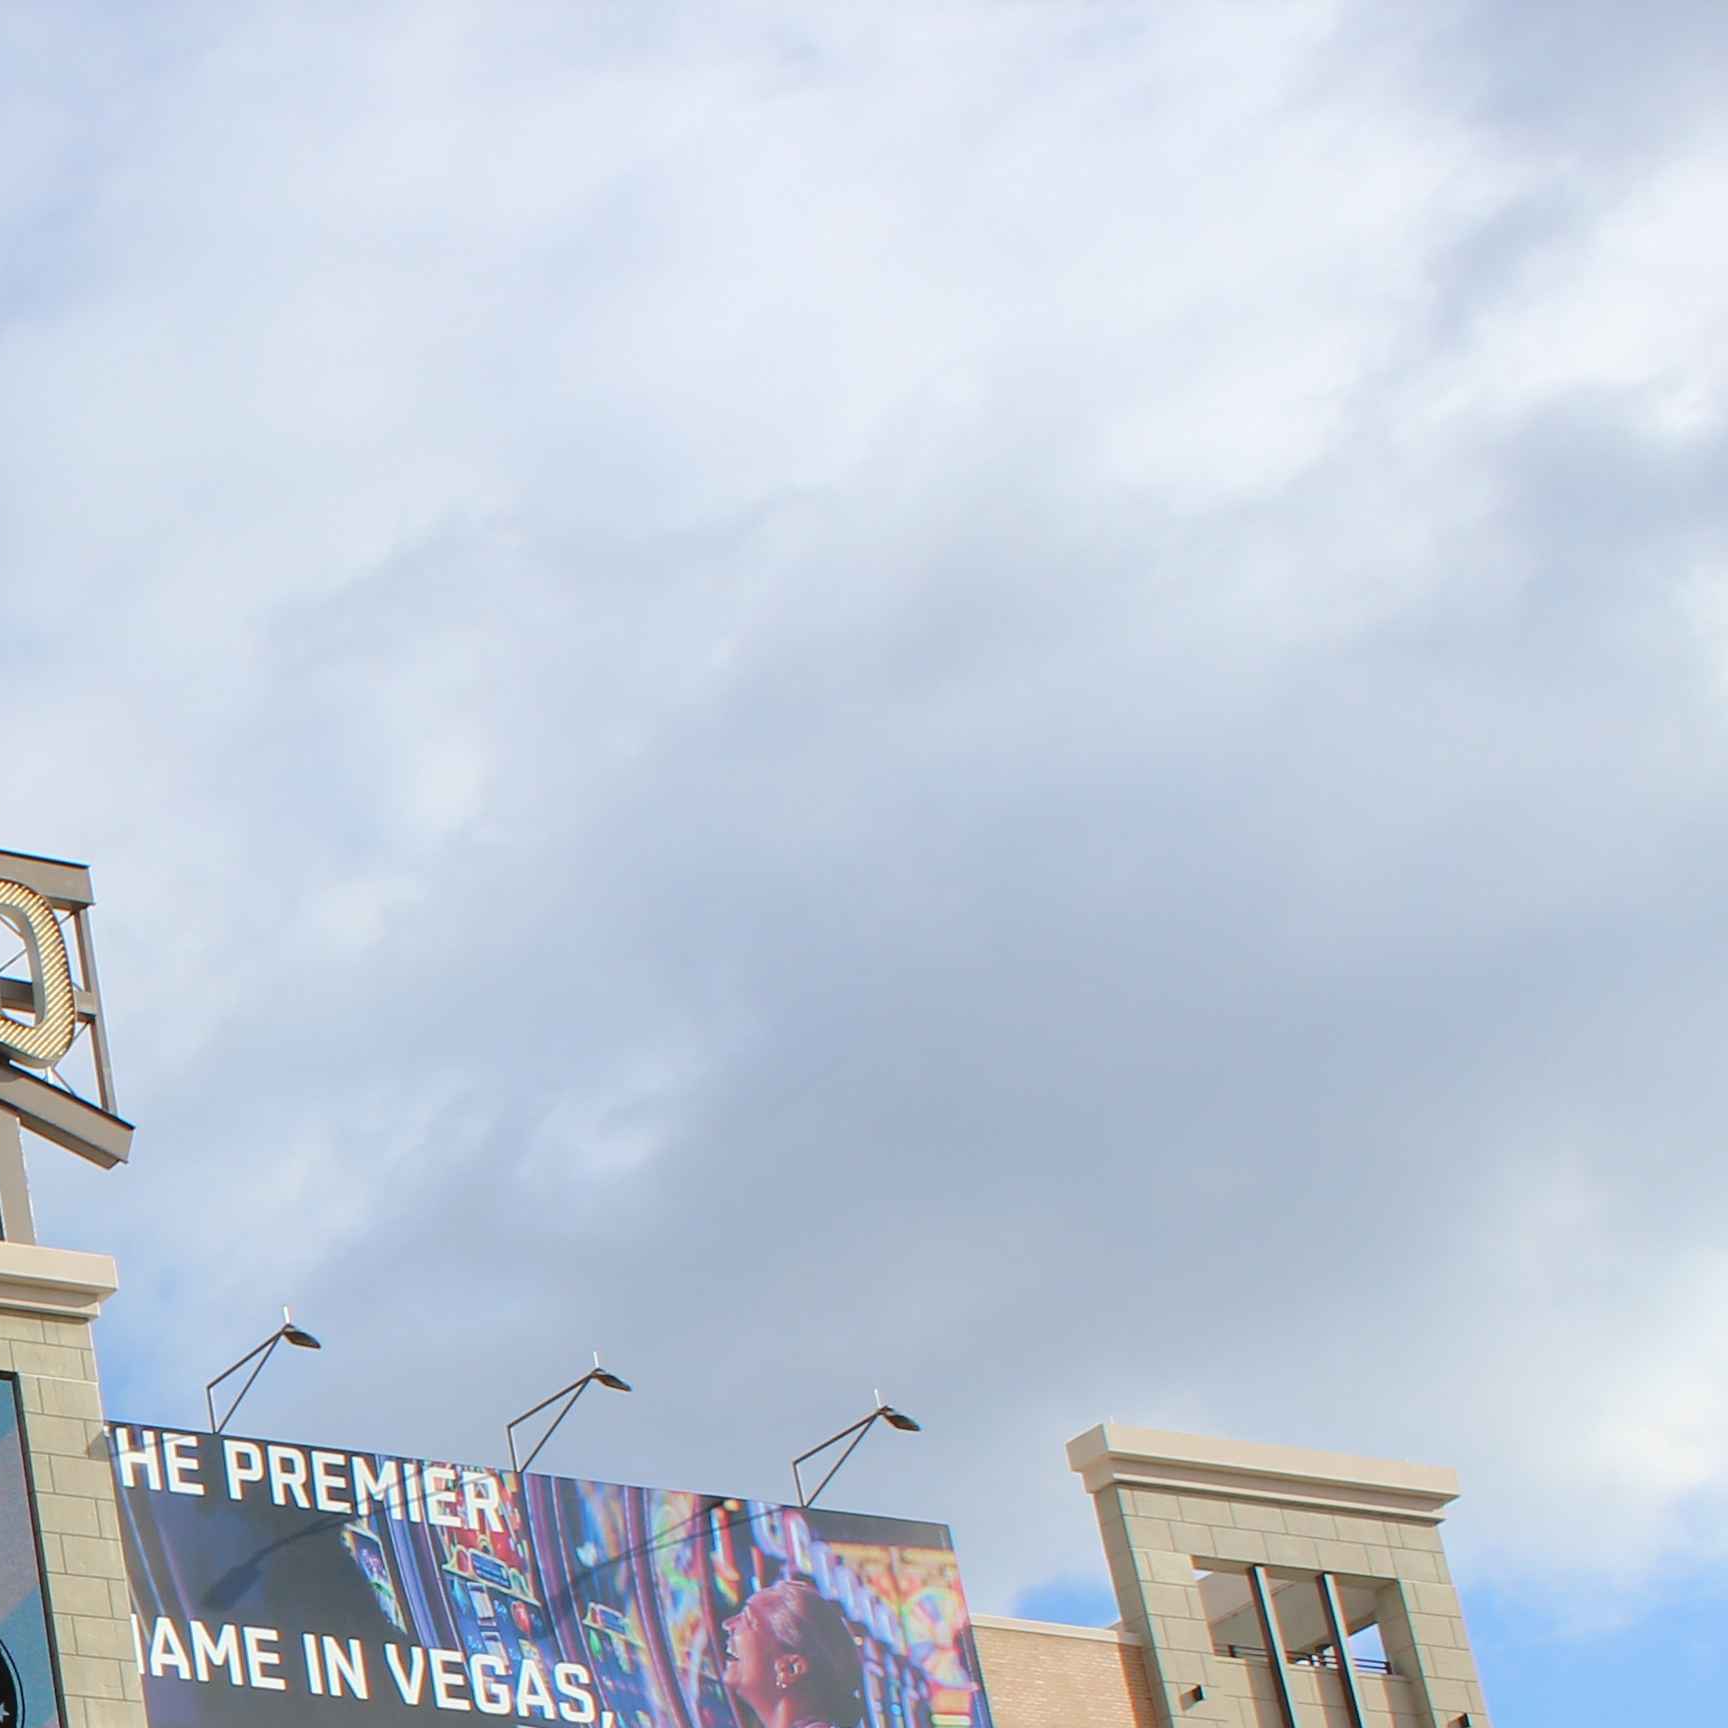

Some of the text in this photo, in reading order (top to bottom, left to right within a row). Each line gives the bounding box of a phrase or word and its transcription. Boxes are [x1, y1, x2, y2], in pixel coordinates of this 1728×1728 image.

[104, 1425, 504, 1533] HE PREMIER
[131, 1613, 287, 1692] AME
[303, 1632, 368, 1700] IN
